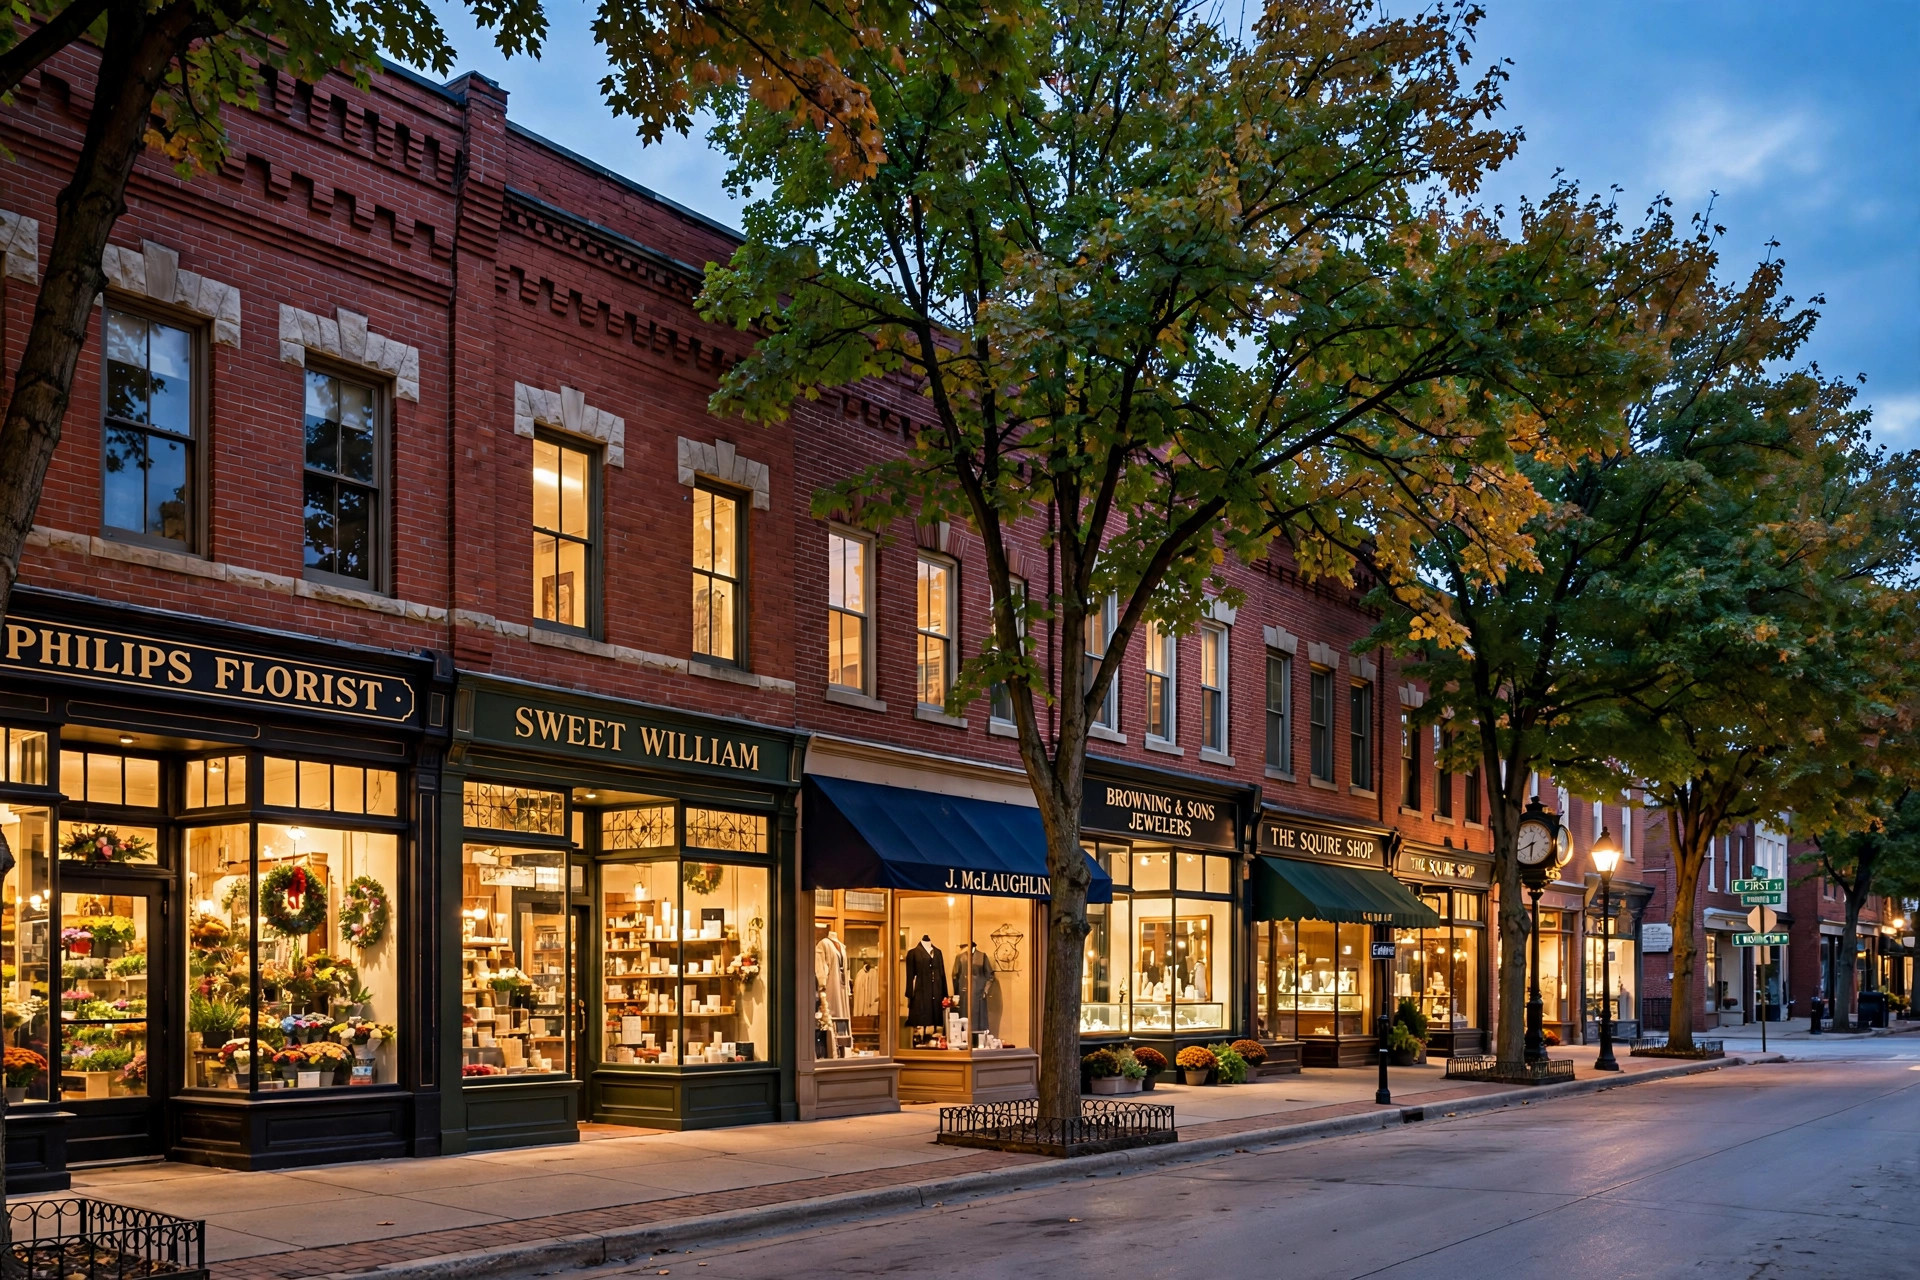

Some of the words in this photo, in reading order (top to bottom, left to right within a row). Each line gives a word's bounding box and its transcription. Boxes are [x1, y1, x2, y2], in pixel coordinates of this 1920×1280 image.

[5, 624, 193, 684] PHILIPS
[215, 656, 383, 711] FLORIST
[515, 706, 626, 752] SWEET
[640, 726, 760, 771] WILLIAM
[1106, 787, 1171, 814] BROWNING
[1175, 799, 1183, 816] &
[1187, 800, 1215, 821] SONS
[1128, 812, 1192, 837] JEWELERS
[1270, 827, 1296, 849] THE
[1300, 832, 1342, 856] SQUIRE
[1346, 839, 1374, 860] SHOP
[945, 868, 957, 889] J.
[961, 870, 1051, 895] McLAUGHLIN
[1744, 880, 1770, 891] FIRST
